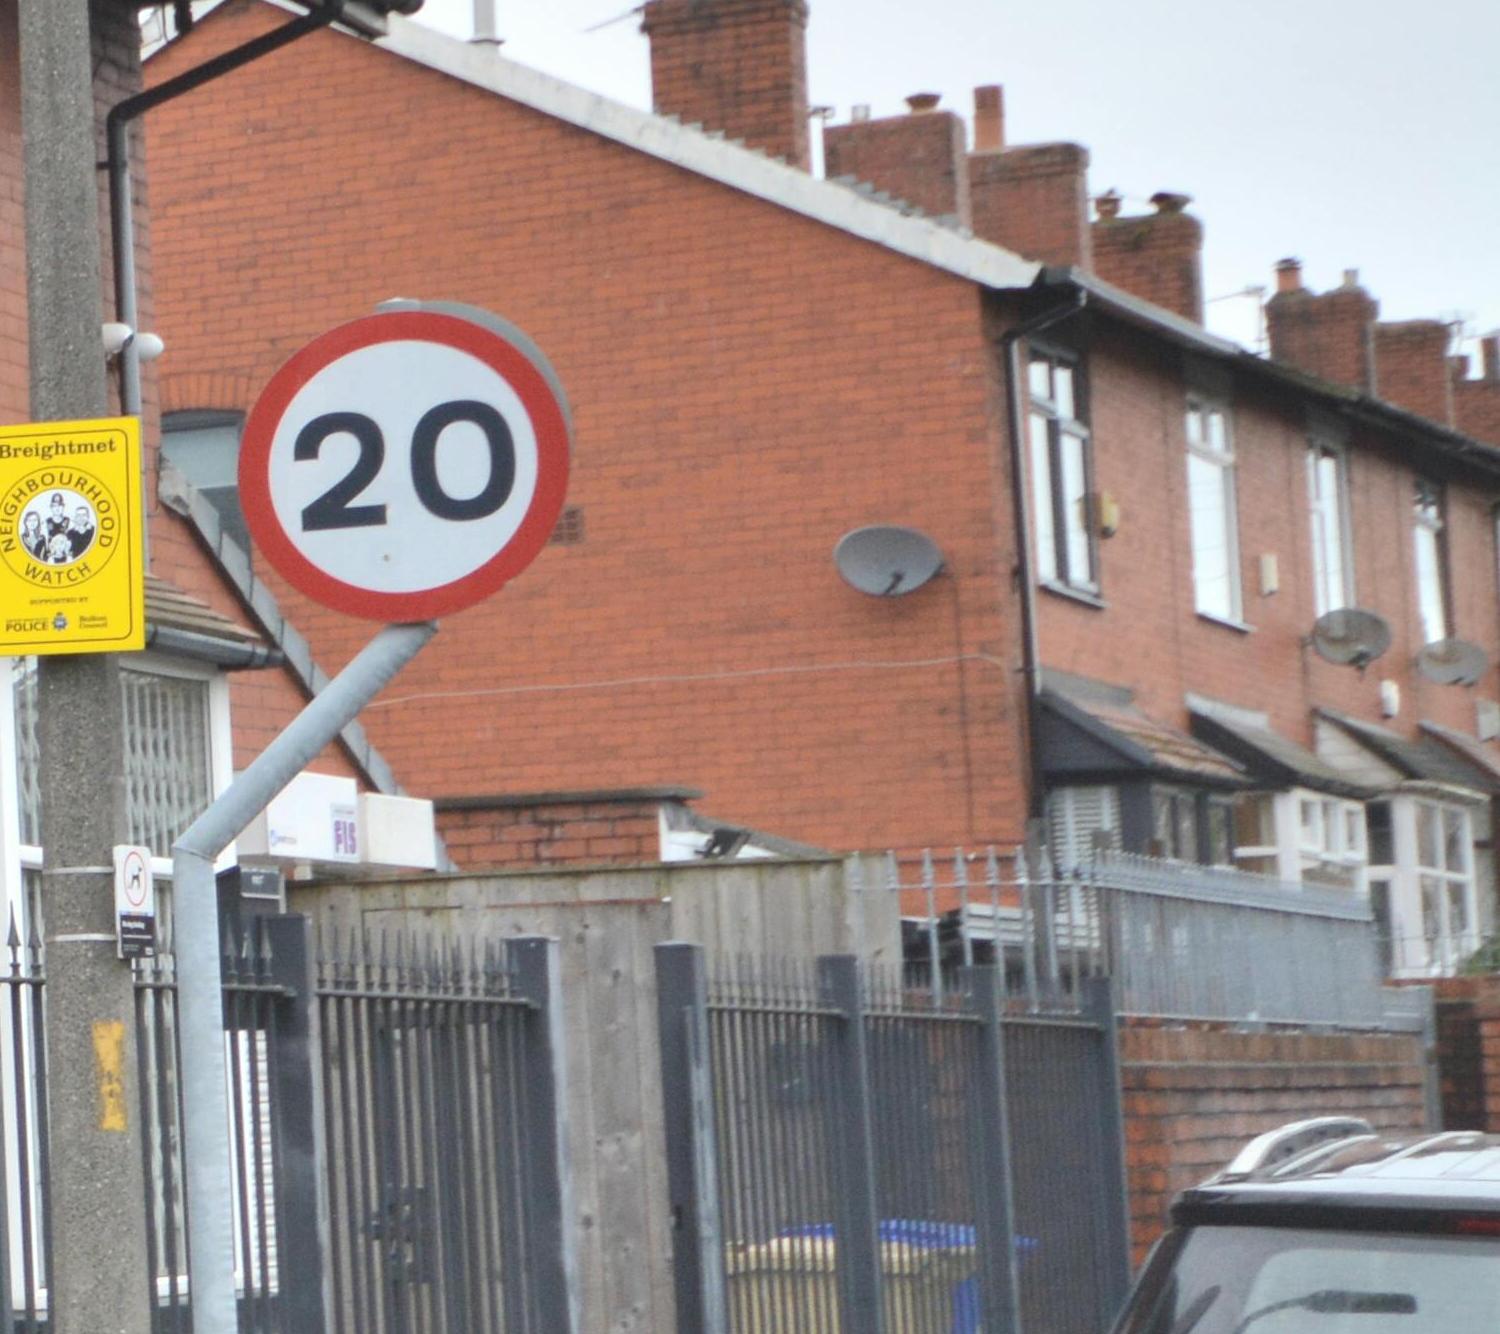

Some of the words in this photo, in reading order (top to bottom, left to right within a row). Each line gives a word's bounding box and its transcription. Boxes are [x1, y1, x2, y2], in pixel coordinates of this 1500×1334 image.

[293, 399, 517, 532] 20
[0, 471, 115, 554] NEIGHBOURHOOD
[24, 563, 93, 585] WATCH
[5, 621, 49, 633] POLICE
[334, 819, 357, 855] FIS
